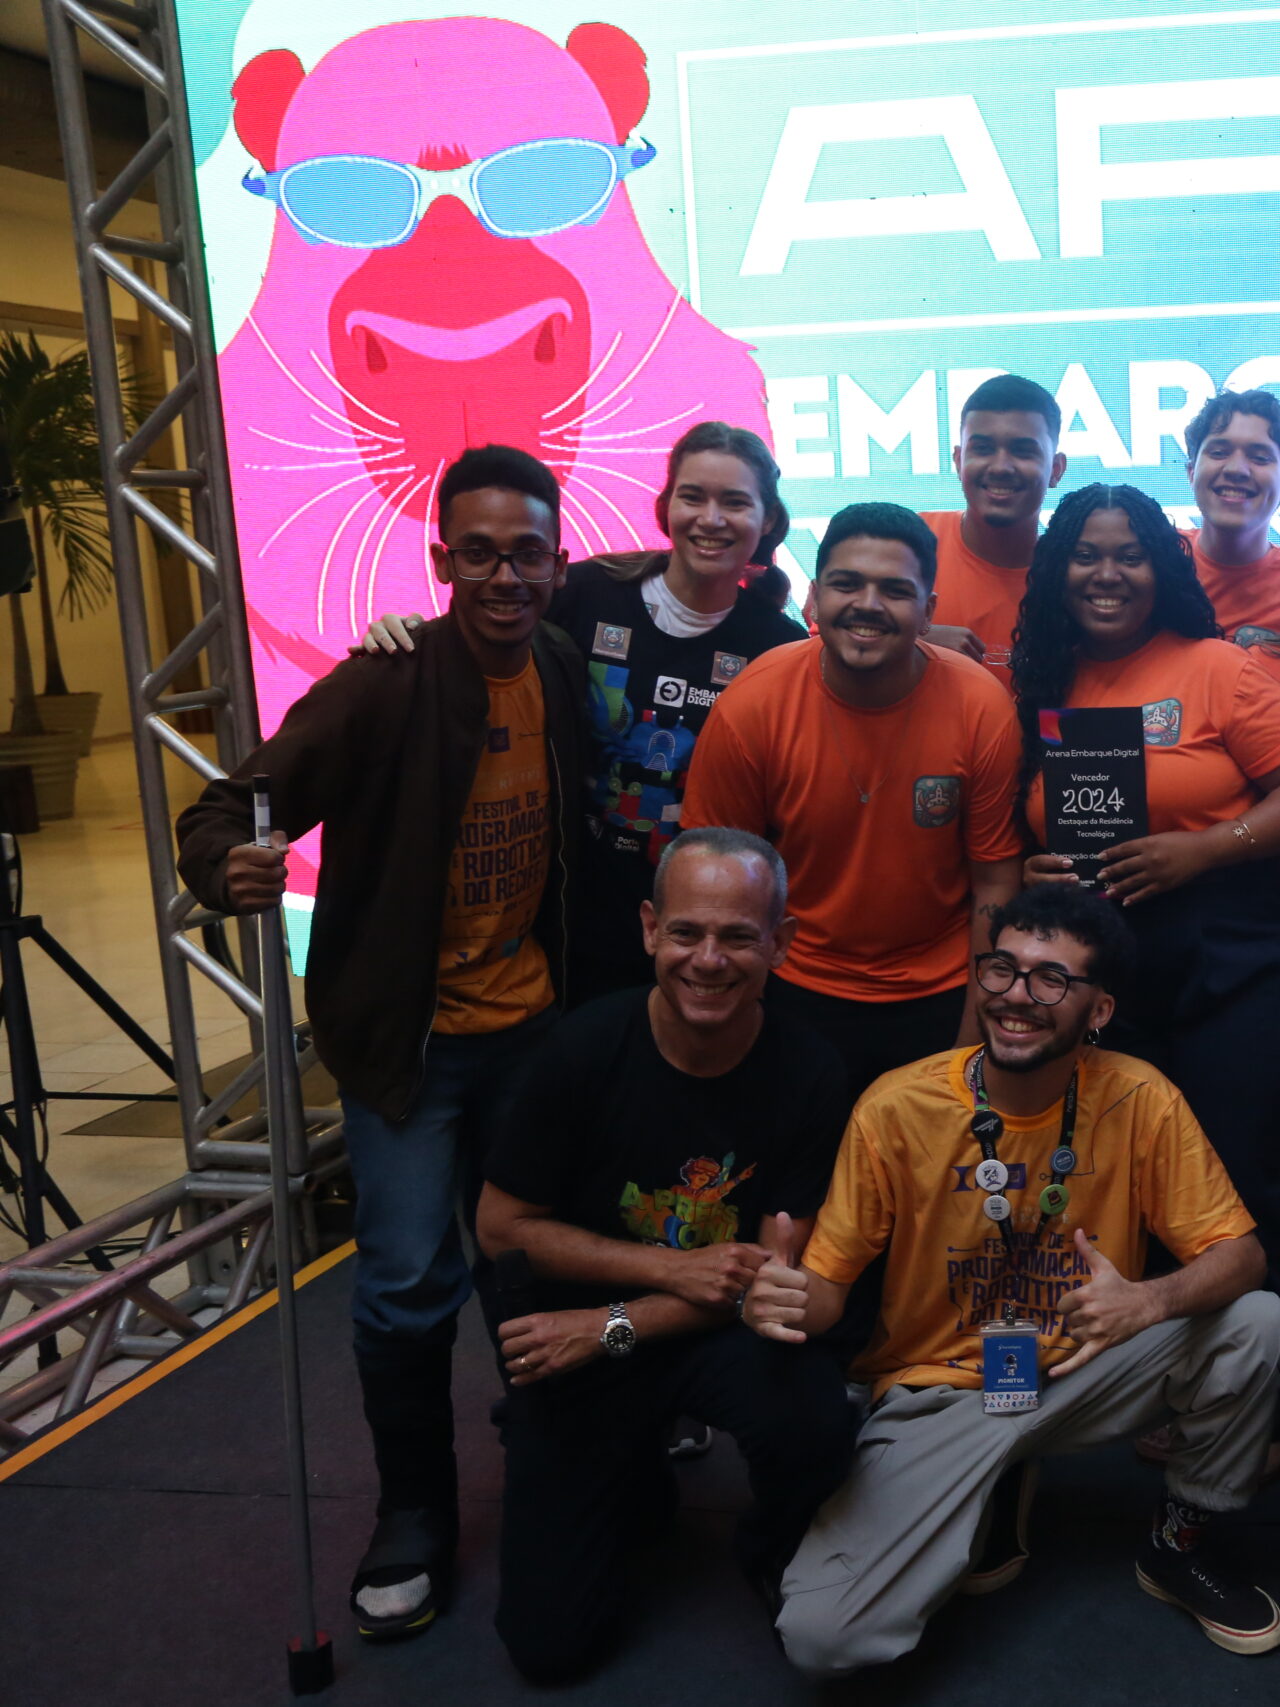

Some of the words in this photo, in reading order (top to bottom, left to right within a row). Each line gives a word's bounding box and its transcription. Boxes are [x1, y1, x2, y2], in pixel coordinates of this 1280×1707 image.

[689, 686, 721, 699] EMBA
[687, 695, 715, 707] DIGIT
[1045, 750, 1071, 758] Arena
[1071, 750, 1113, 759] Embarque
[1113, 749, 1140, 759] Digital
[1071, 773, 1110, 781] Vencedor
[1062, 787, 1125, 813] 2024
[1057, 818, 1089, 826] Destaque
[1099, 817, 1134, 825] Residência
[1076, 830, 1115, 838] Tecnológica
[1048, 1231, 1065, 1249] DE
